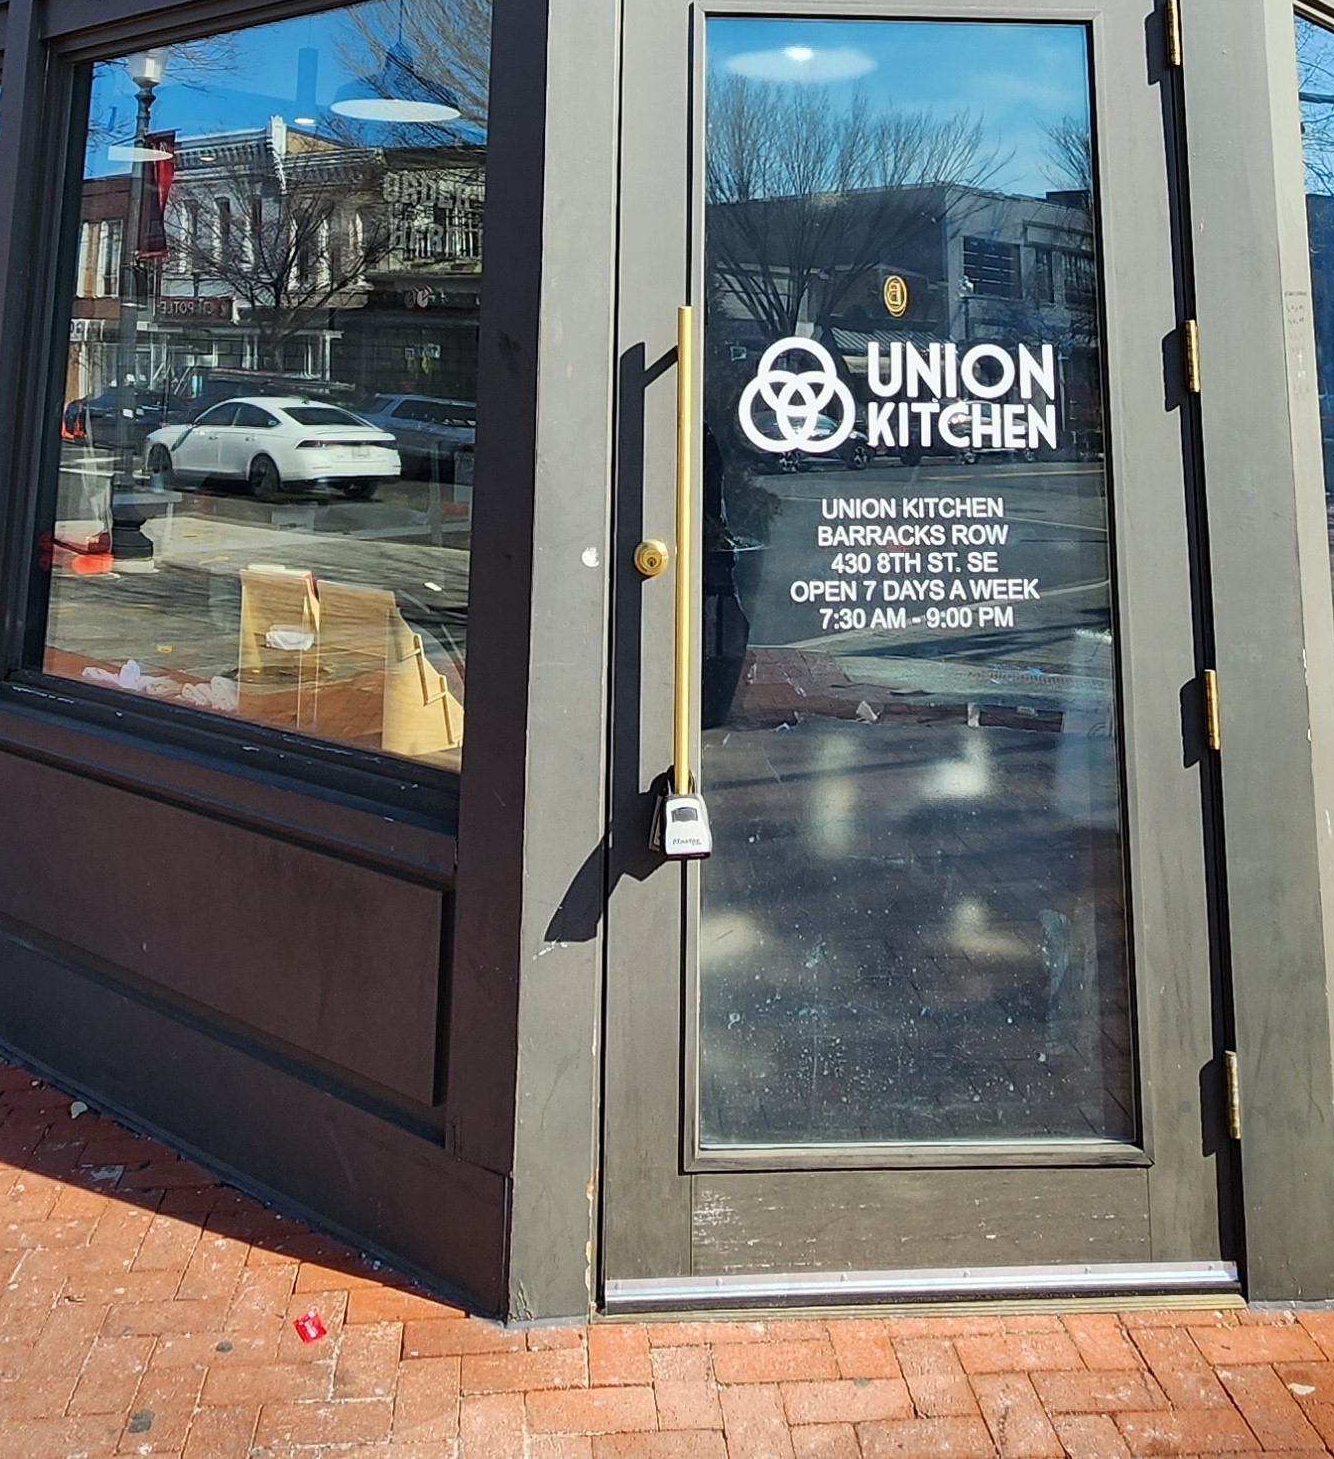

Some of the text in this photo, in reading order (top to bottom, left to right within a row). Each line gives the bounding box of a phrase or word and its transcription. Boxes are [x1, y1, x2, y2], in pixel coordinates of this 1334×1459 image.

[867, 340, 1055, 401] UNION
[867, 401, 1057, 450] KITCHEN
[822, 497, 1004, 520] UNION KITCHEN
[817, 524, 1009, 547] BARRACKS ROW
[831, 551, 999, 574] 430 8TH ST. SE
[790, 578, 1040, 602] OPEN 7 DAYS A WEEK
[819, 607, 867, 630] 7:30
[869, 607, 906, 629] AM
[926, 606, 973, 628] 9:00
[978, 606, 1014, 627] PM
